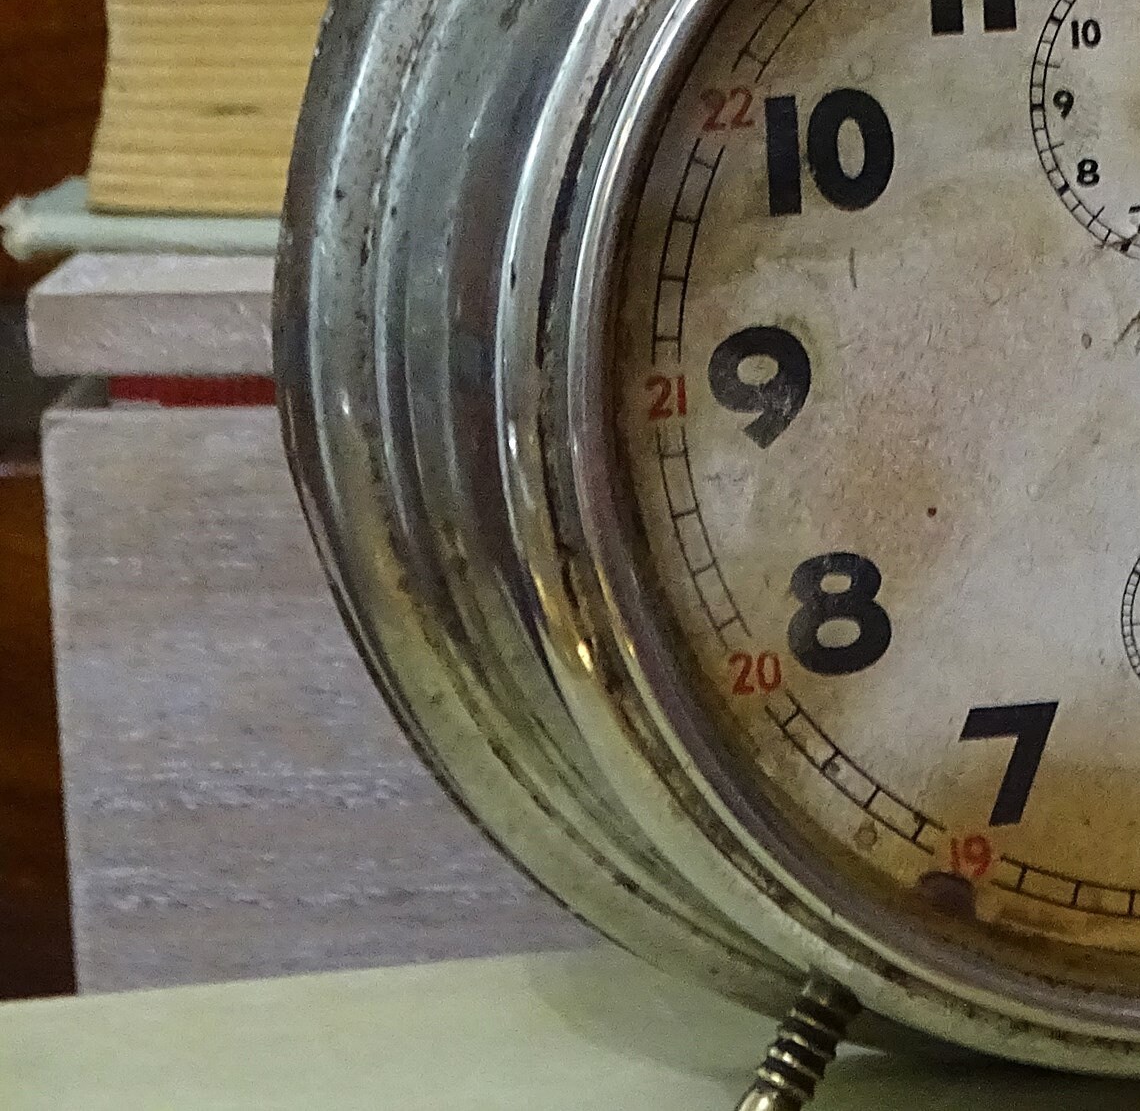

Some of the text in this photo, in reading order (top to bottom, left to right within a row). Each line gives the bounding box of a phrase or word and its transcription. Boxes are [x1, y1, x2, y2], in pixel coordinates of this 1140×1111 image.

[1071, 19, 1101, 49] 10
[701, 90, 754, 131] 22
[1053, 90, 1074, 119] 9
[765, 88, 894, 216] 10
[1077, 159, 1100, 186] 8
[647, 376, 687, 420] 21
[708, 326, 811, 449] 9
[787, 551, 892, 676] 8
[728, 652, 782, 695] 20
[958, 701, 1060, 827] 7
[950, 835, 994, 876] 19
